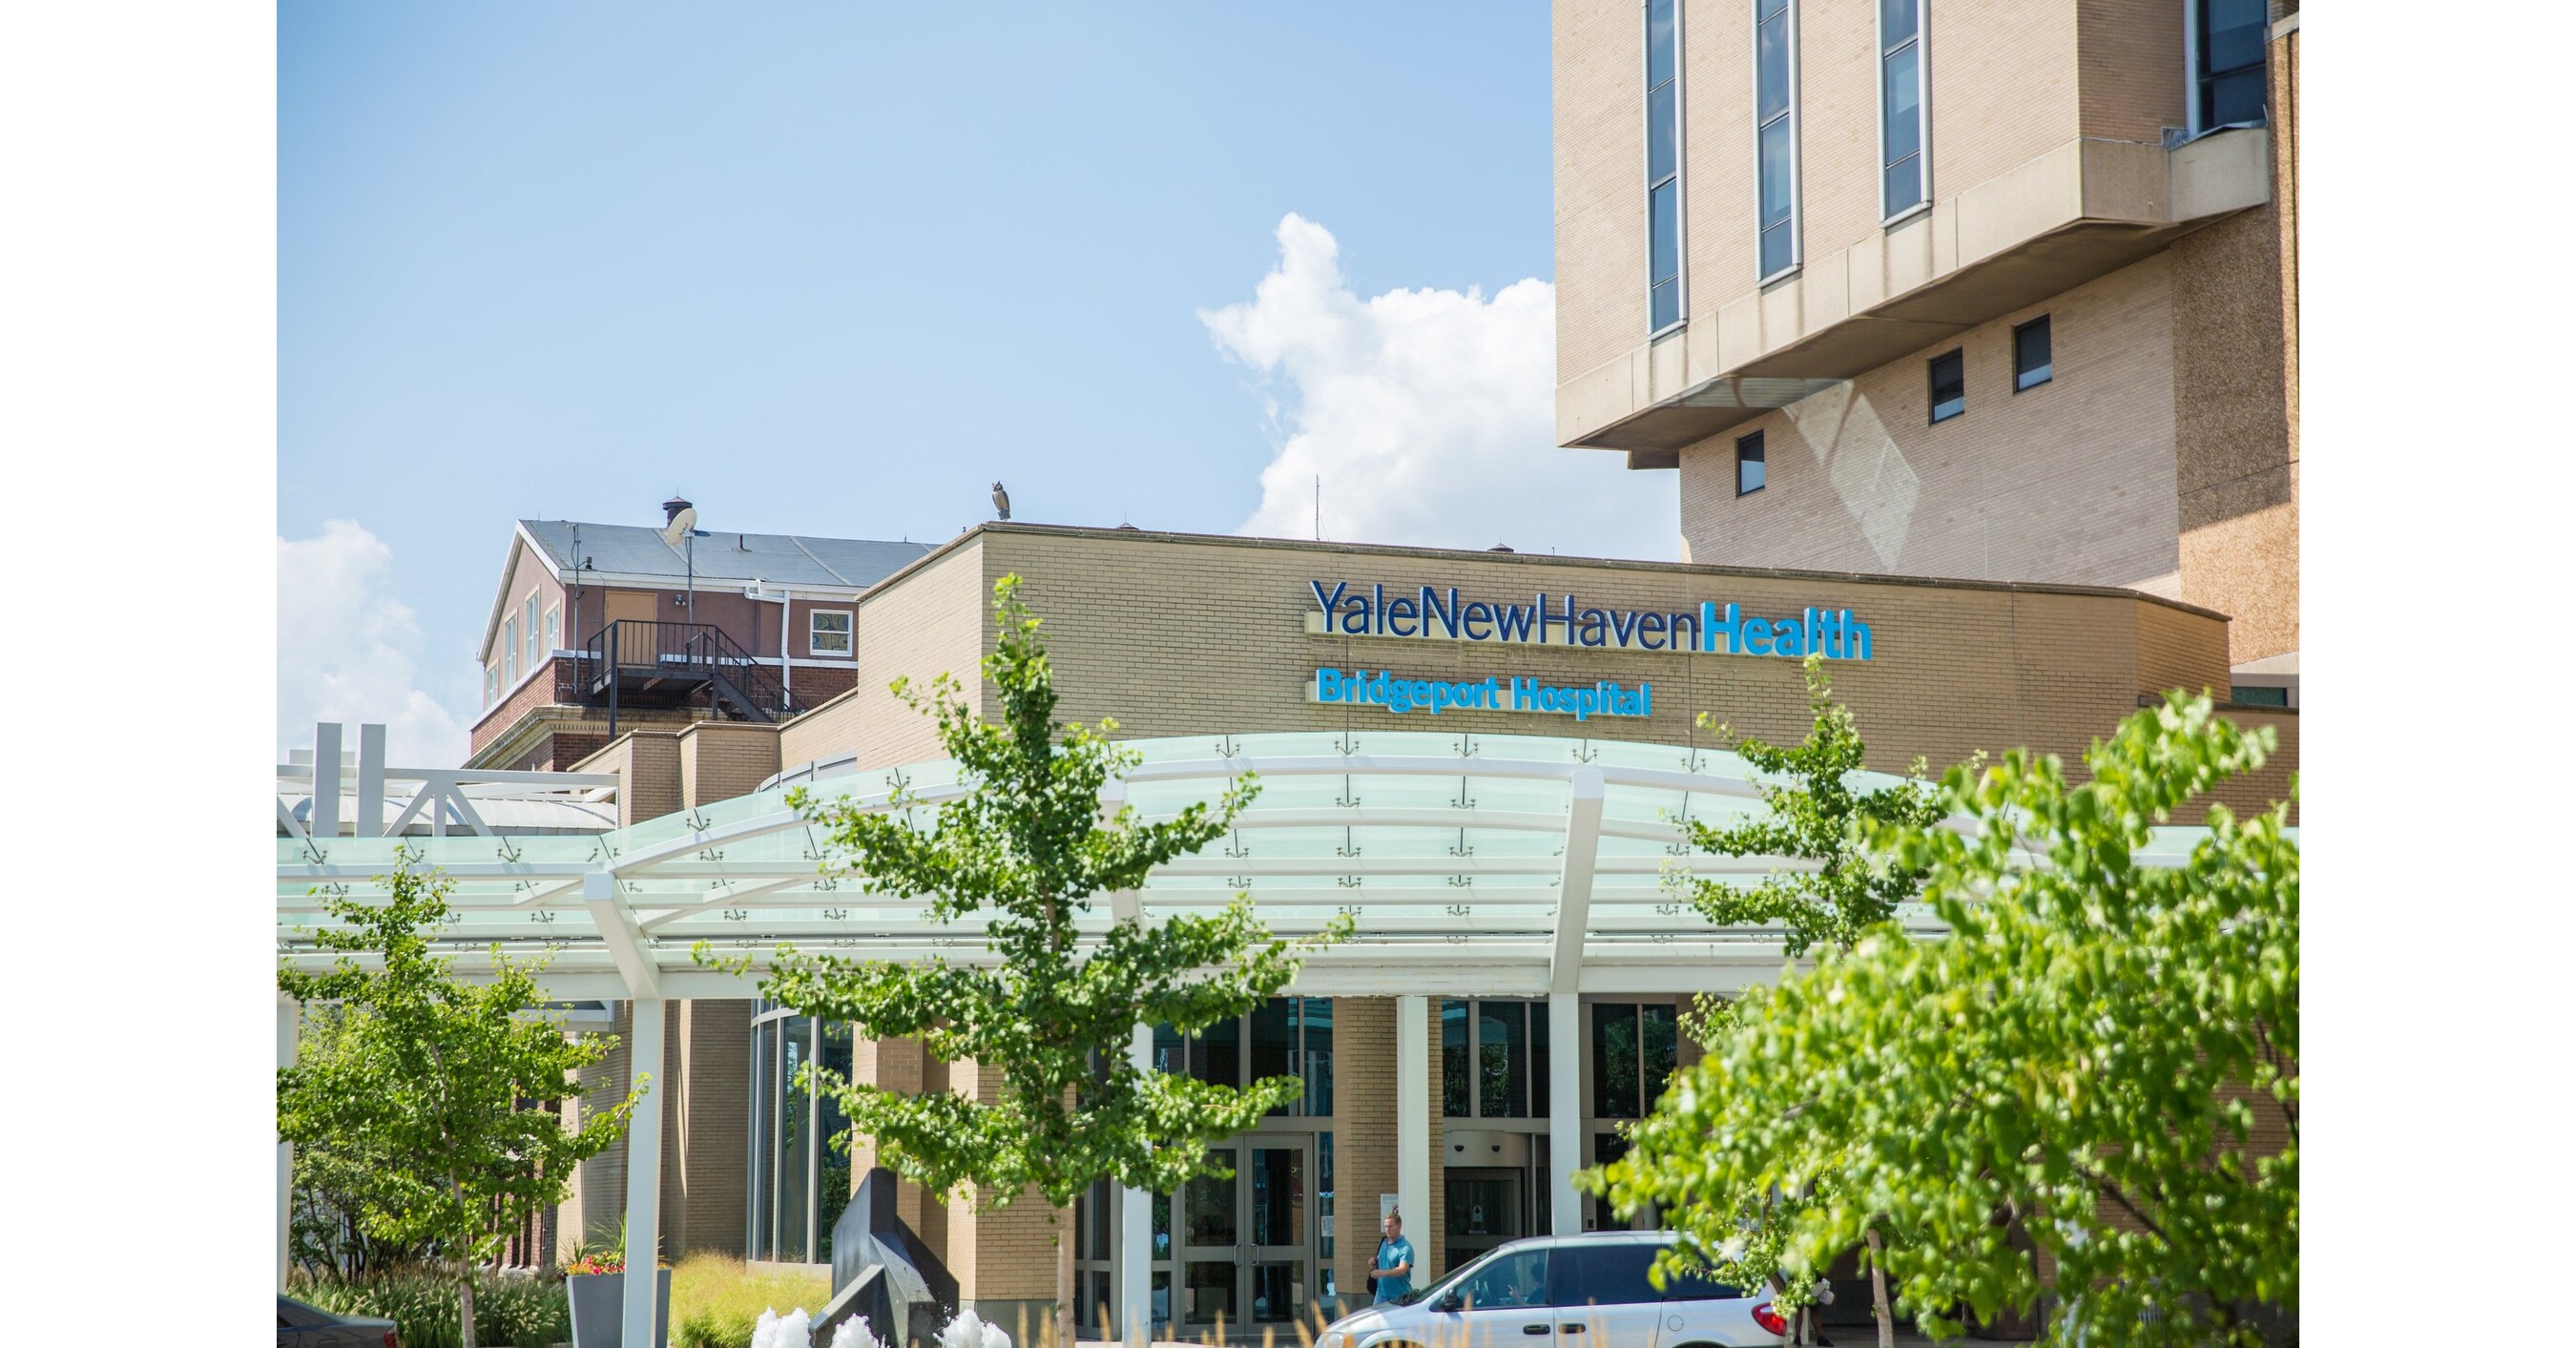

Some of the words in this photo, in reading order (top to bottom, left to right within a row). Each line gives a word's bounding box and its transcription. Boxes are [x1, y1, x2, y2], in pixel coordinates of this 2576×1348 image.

[1309, 580, 1872, 660] YaleNewHavenHealth
[1316, 668, 1500, 715] Bridgeport
[1510, 676, 1652, 721] Hospital
